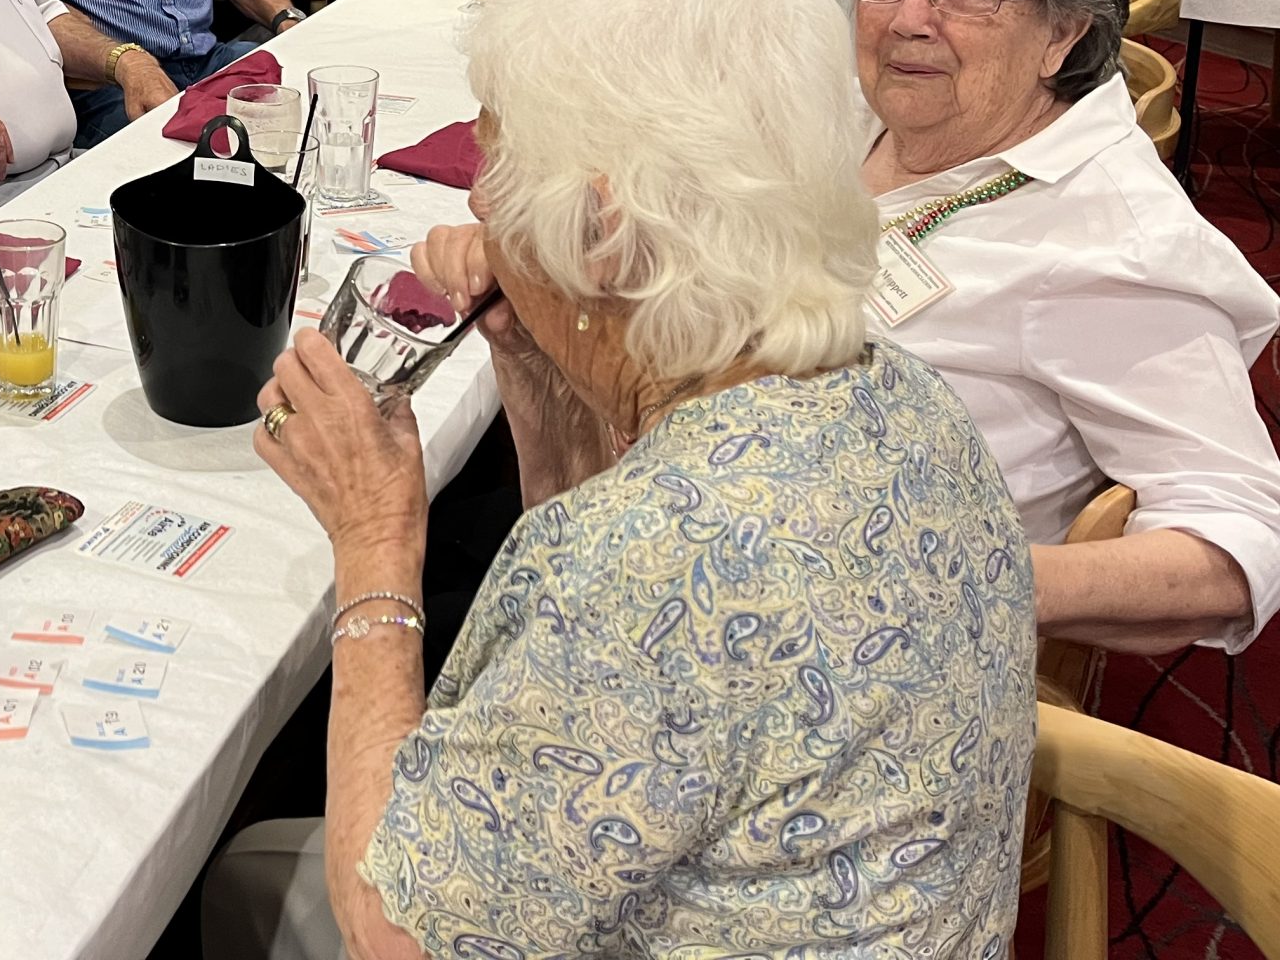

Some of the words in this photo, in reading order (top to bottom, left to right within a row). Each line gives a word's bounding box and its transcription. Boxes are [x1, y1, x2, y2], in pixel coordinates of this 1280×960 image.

[200, 162, 247, 177] LADIES
[157, 619, 172, 632] 21
[28, 660, 42, 672] 02
[133, 662, 146, 675] 20
[4, 699, 18, 712] 01
[105, 711, 120, 725] 19
[113, 727, 128, 737] A
